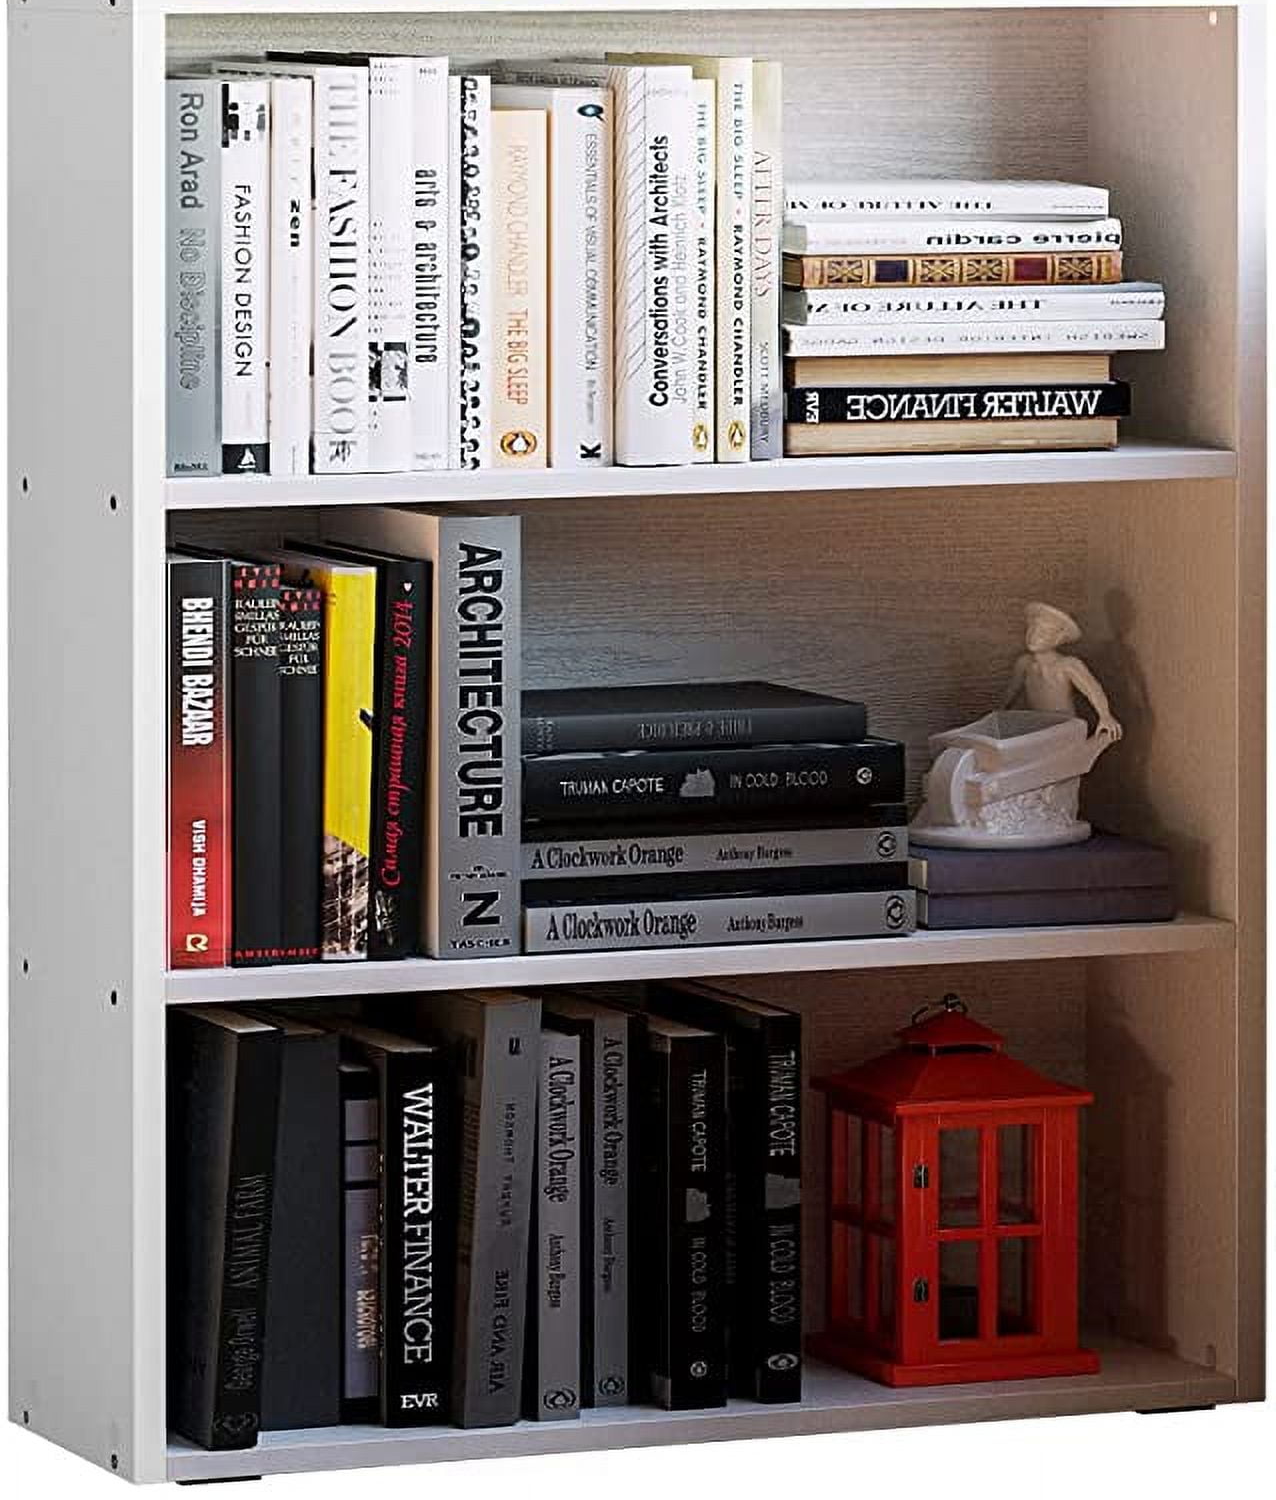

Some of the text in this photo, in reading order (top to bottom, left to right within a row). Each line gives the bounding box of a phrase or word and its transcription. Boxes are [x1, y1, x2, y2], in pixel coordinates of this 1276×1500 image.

[179, 92, 204, 208] Ron Arad
[415, 169, 437, 207] arts
[585, 133, 597, 204] ESSENTIALS
[733, 82, 744, 200] THE BIG SLEEP
[290, 200, 299, 247] zen
[329, 170, 357, 337] FASHION
[507, 144, 527, 296] RAYMOND CHANDLER
[585, 206, 597, 223] OF
[585, 225, 597, 267] VISUAL
[754, 151, 774, 298] AFTER DAYS
[174, 228, 204, 390] No Discipline
[235, 185, 251, 376] FASHION DESIGN
[415, 242, 441, 363] architecture
[585, 268, 597, 371] COMMUNICATION
[648, 135, 669, 407] Conversations with Architects
[733, 224, 744, 406] RAYMOND CHANDLER
[507, 308, 527, 405] THE BIG SLEEP
[697, 237, 707, 410] RAYMOND CHANDLER
[182, 597, 213, 745] BHENDI BAZAAR
[391, 600, 414, 648] 2014
[457, 542, 503, 838] ARCHITECTURE
[560, 776, 664, 797] TRUMAN CAPOTE
[729, 770, 828, 789] IN COLD BLOOD
[191, 819, 206, 917] VISH DHAMIJA
[381, 821, 403, 887] Самая
[531, 843, 683, 870] A Clockwork Orange
[716, 845, 793, 862] Anthony Burgess
[546, 910, 697, 941] A Clockwork Orange
[726, 914, 803, 933] Anthony Burgess
[544, 1056, 575, 1202] A Clockwork Orange
[600, 1036, 623, 1186] A Clockwork Orange
[692, 1069, 706, 1172] TRUMAN CAPOTE
[769, 1050, 795, 1156] TRUMAN CAPOTE
[403, 1083, 432, 1364] WALTER FINANCE
[691, 1252, 706, 1284] COLD
[770, 1240, 795, 1273] COLD
[401, 1392, 438, 1409] EVR
